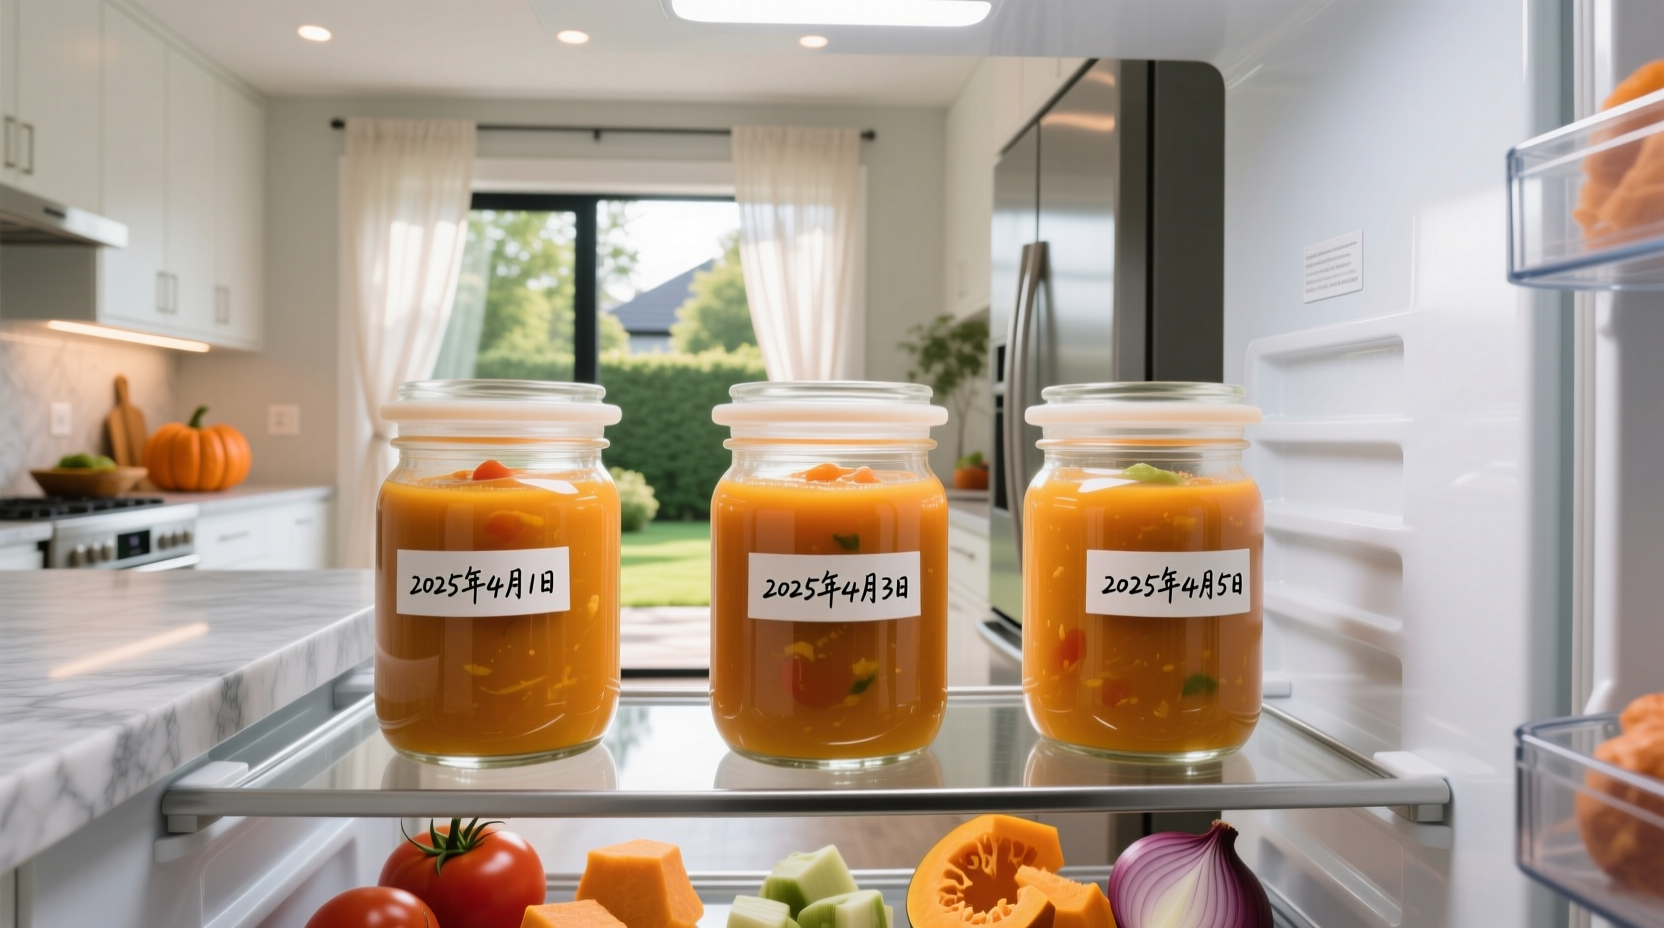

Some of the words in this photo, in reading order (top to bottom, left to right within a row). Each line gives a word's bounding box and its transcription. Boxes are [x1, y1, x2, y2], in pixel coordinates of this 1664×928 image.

[409, 566, 554, 605] 2025年4月1日
[762, 570, 908, 609] 2025年4月3日
[1101, 566, 1243, 604] 2025年4月5日
